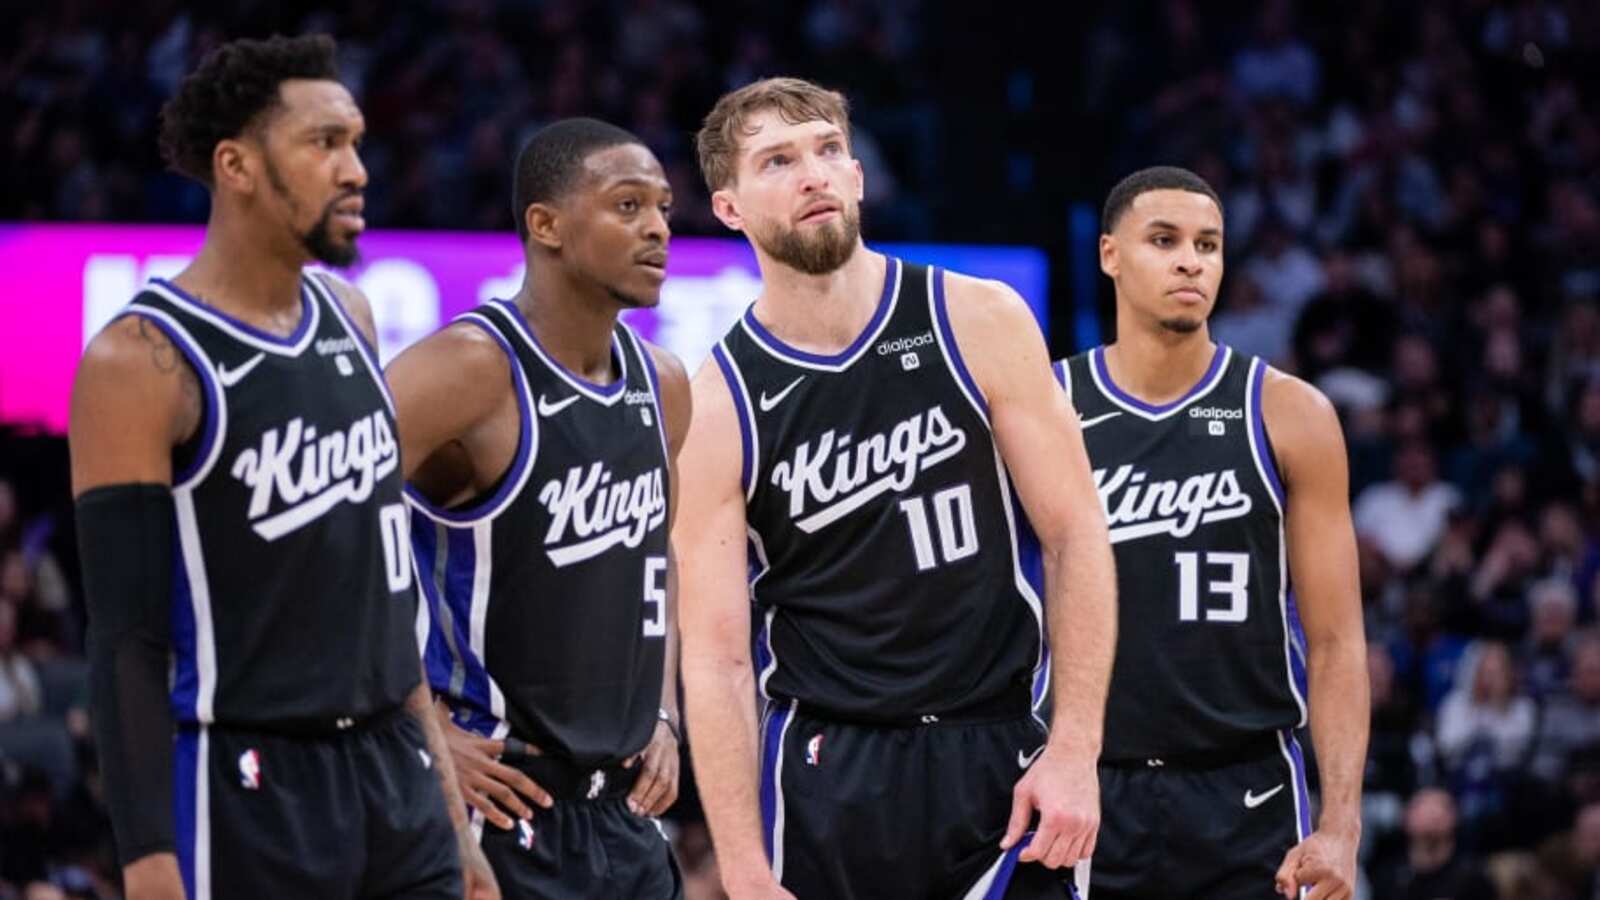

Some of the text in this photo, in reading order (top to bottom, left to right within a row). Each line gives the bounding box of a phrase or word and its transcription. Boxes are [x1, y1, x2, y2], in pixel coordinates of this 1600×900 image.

[877, 330, 934, 355] dialpad
[624, 389, 654, 405] dalp
[1189, 406, 1243, 421] dialpad
[231, 409, 398, 541] Kings
[769, 405, 966, 533] Kings
[379, 503, 412, 593] 0
[539, 462, 666, 568] Kings
[899, 484, 979, 571] 10
[642, 557, 667, 637] 5
[1174, 551, 1250, 622] 13
